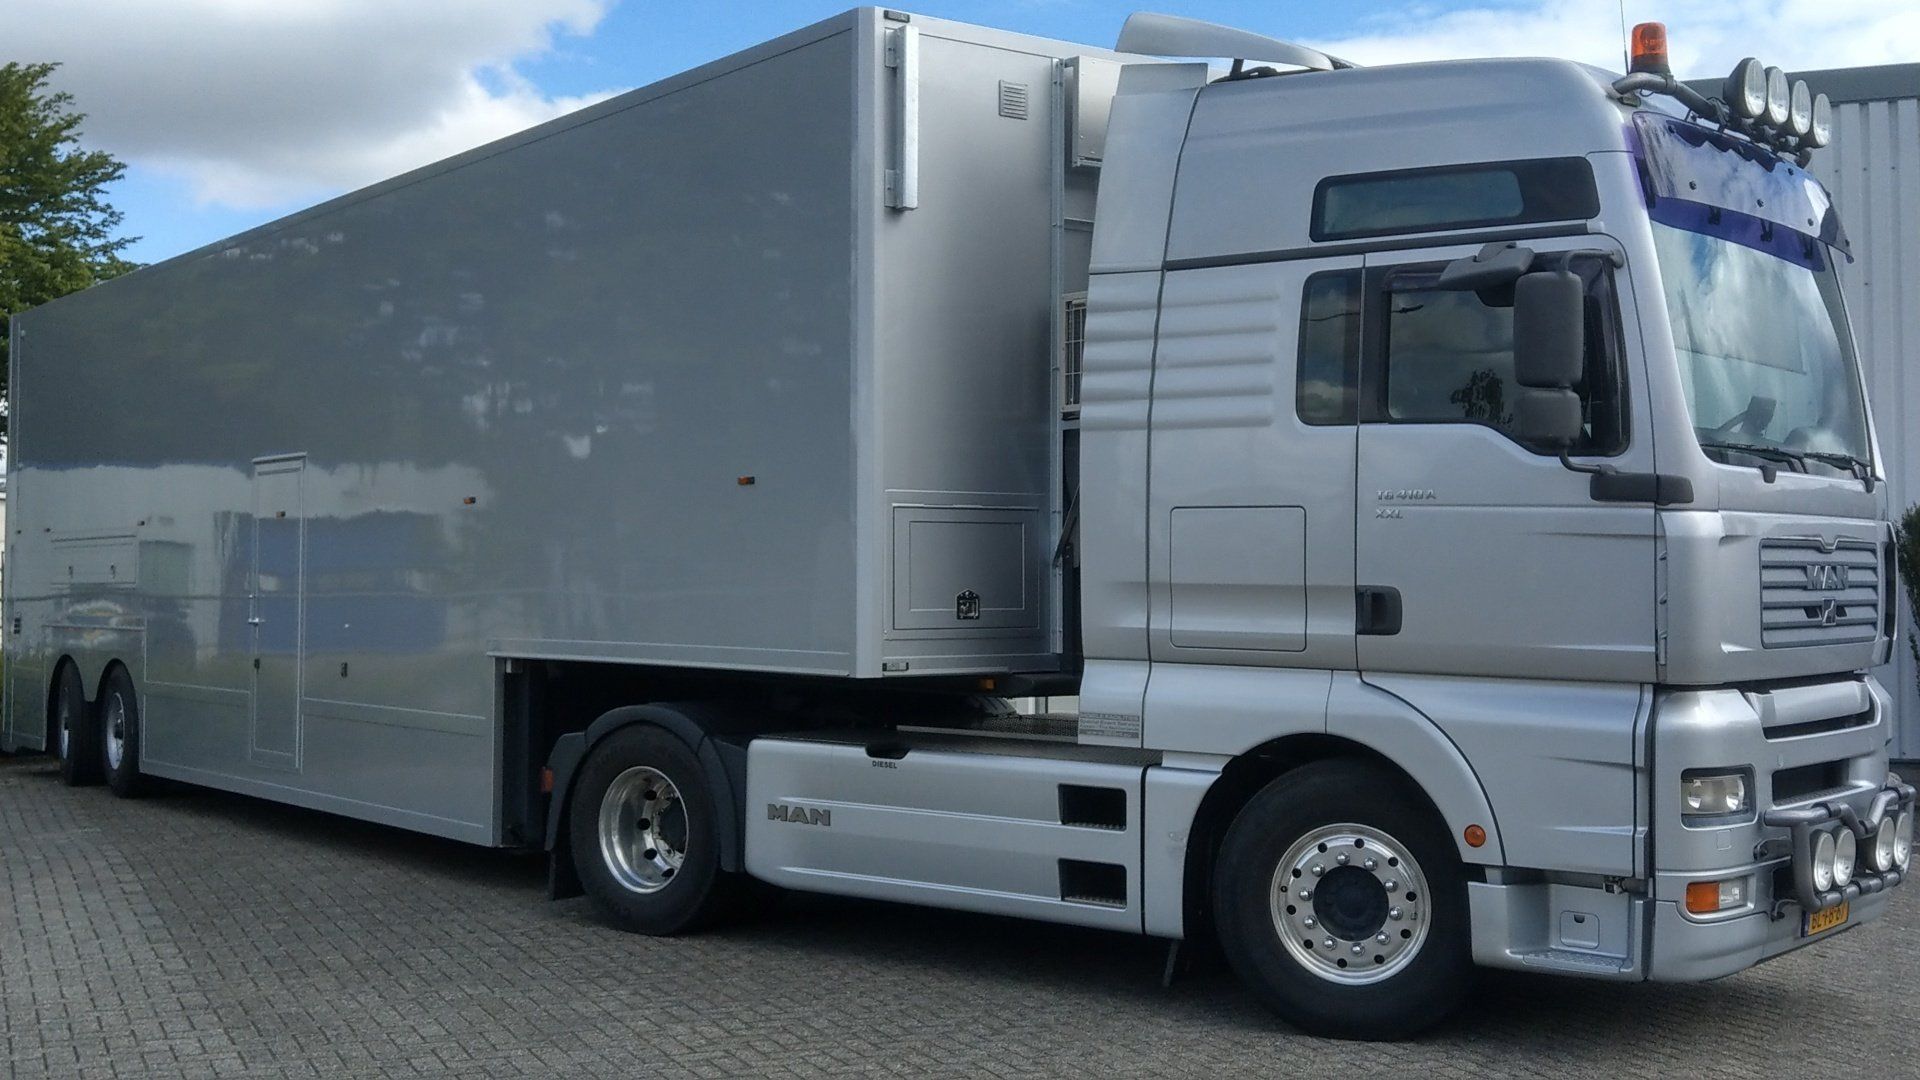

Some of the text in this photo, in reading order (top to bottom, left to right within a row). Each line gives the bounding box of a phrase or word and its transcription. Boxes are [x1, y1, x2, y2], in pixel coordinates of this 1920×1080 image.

[1376, 509, 1403, 519] XXL
[1806, 564, 1849, 590] MAN
[872, 760, 898, 769] DIESEL
[767, 803, 831, 827] MAN
